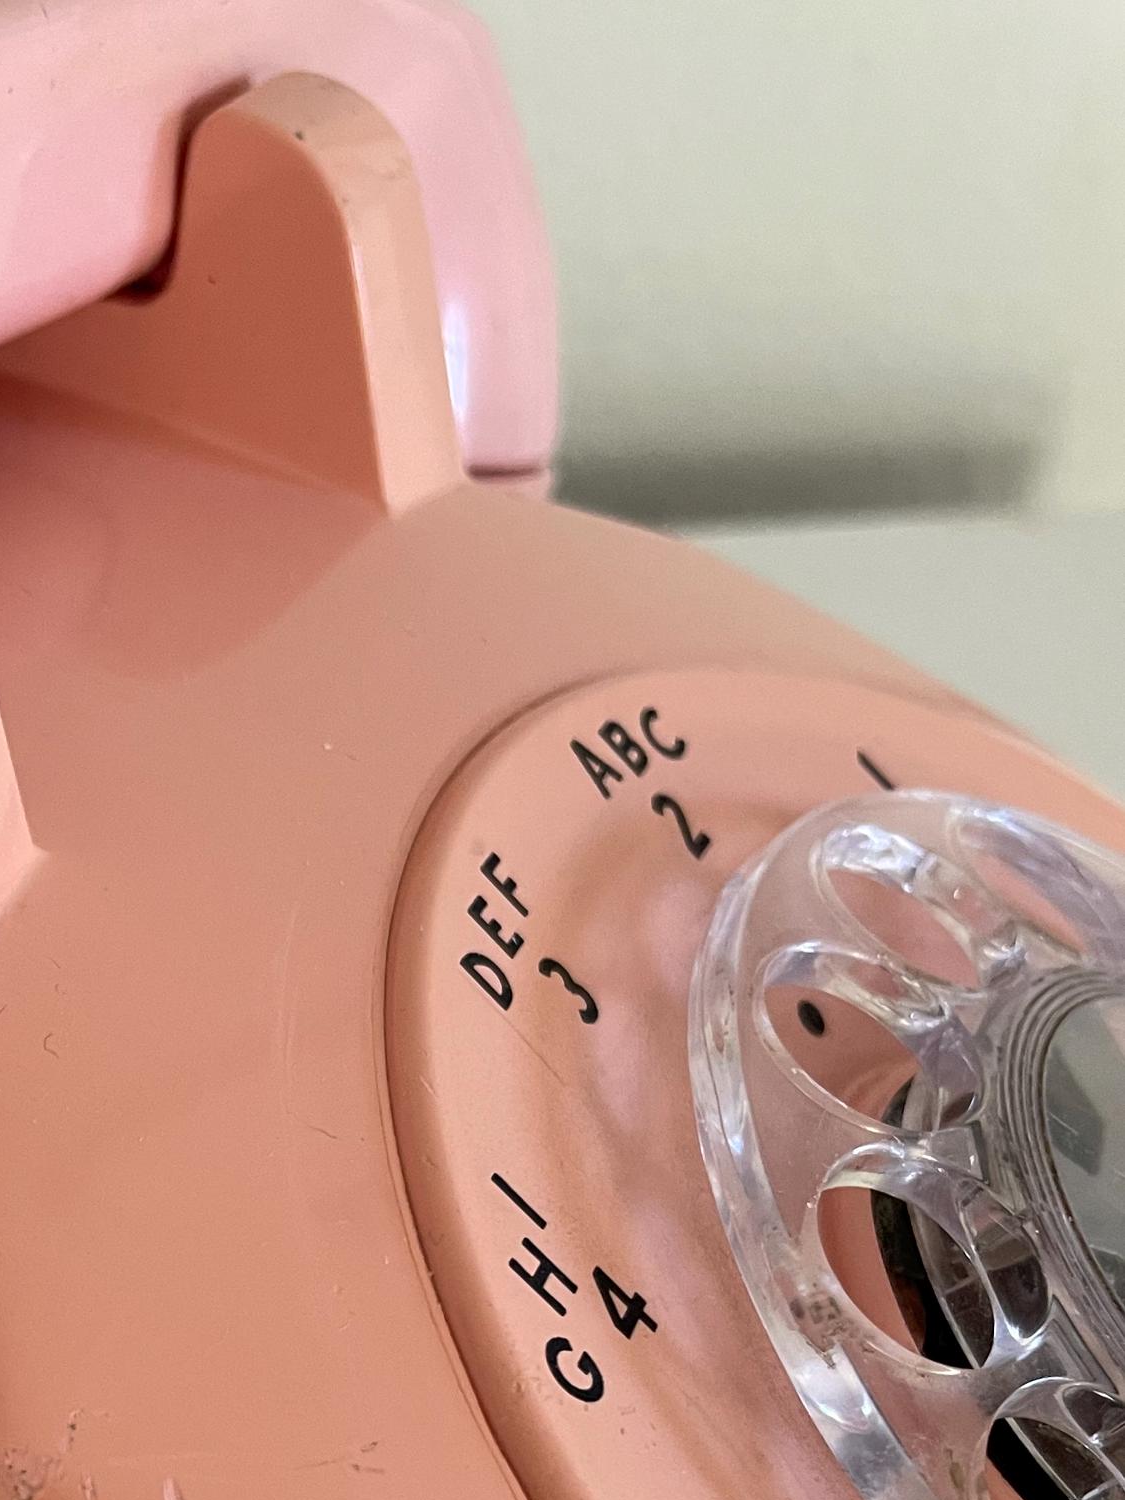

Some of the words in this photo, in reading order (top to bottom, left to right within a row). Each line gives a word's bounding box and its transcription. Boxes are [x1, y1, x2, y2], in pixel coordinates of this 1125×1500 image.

[570, 707, 687, 800] ABC
[651, 793, 712, 860] 2
[460, 852, 529, 1011] DEF
[538, 957, 599, 1025] 3
[491, 1173, 605, 1404] GHI
[593, 1266, 659, 1340] 4
